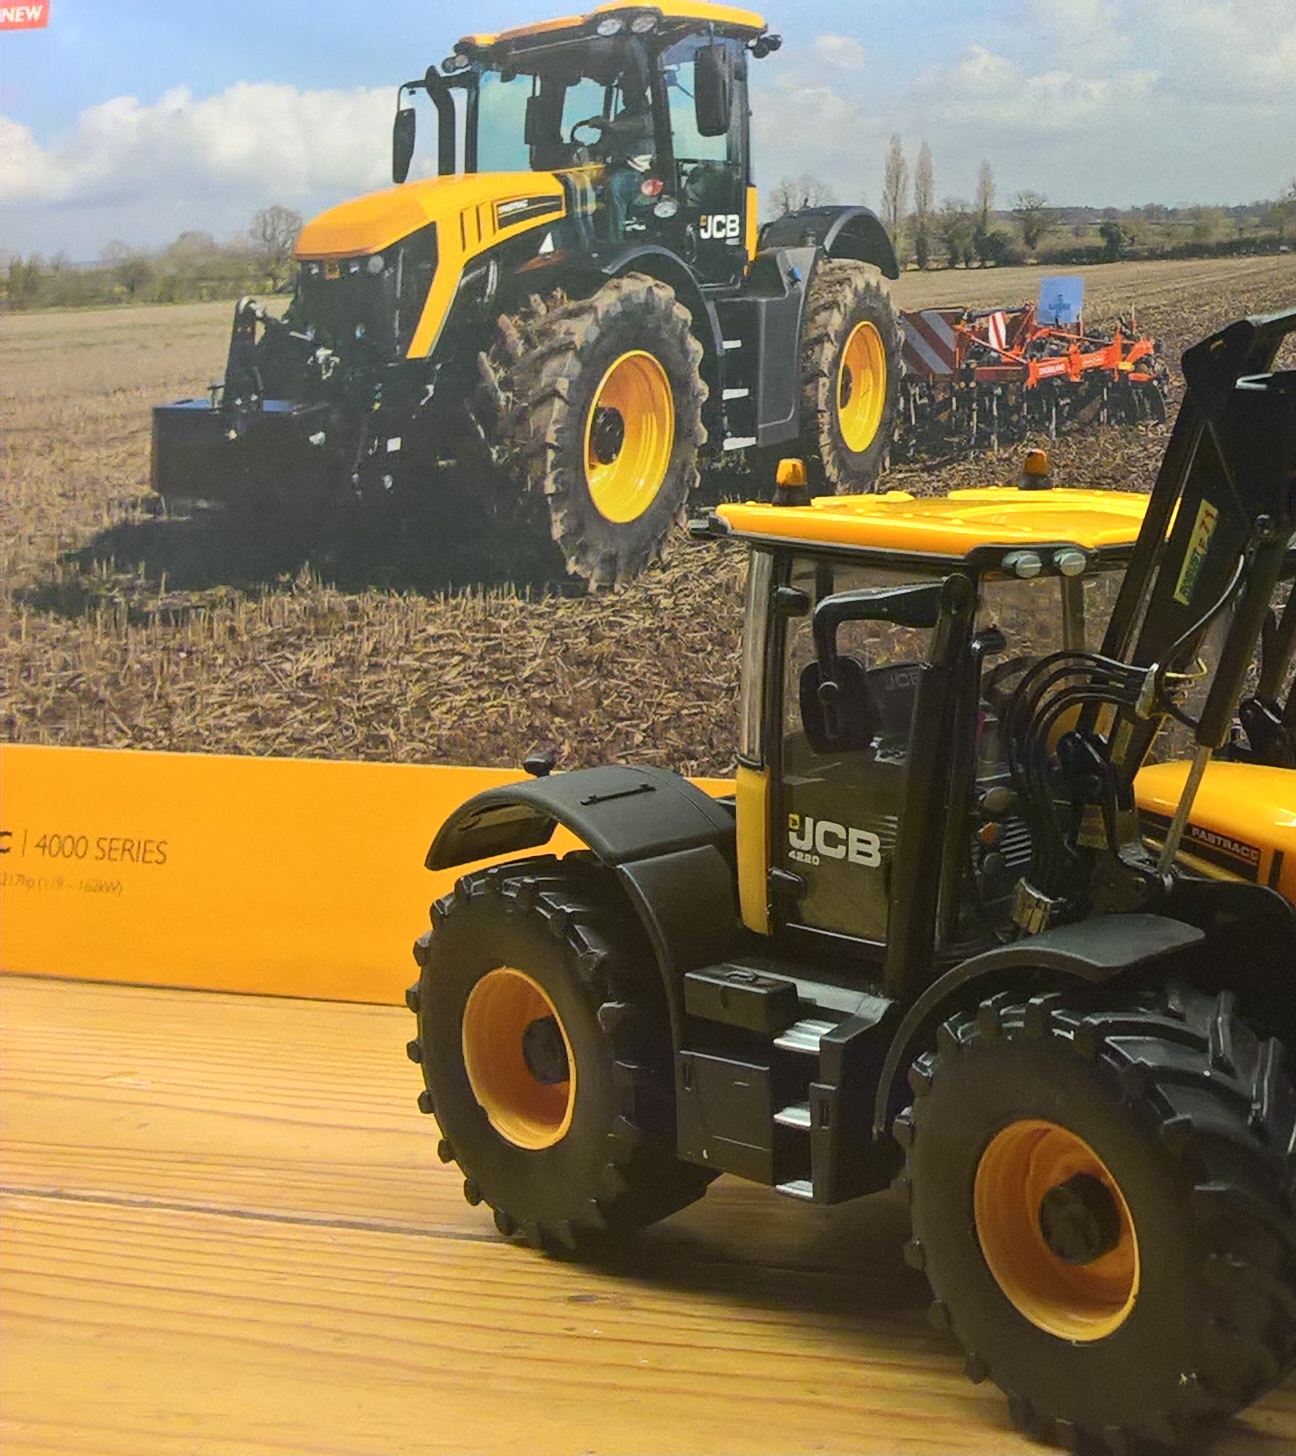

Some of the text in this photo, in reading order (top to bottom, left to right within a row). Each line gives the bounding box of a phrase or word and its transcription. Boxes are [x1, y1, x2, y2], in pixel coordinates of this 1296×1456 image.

[0, 5, 43, 22] NEW
[700, 214, 740, 239] JCB
[34, 833, 89, 859] 4000
[94, 836, 168, 865] SERIES
[788, 813, 881, 868] JCB
[1192, 827, 1250, 858] FASTRAC
